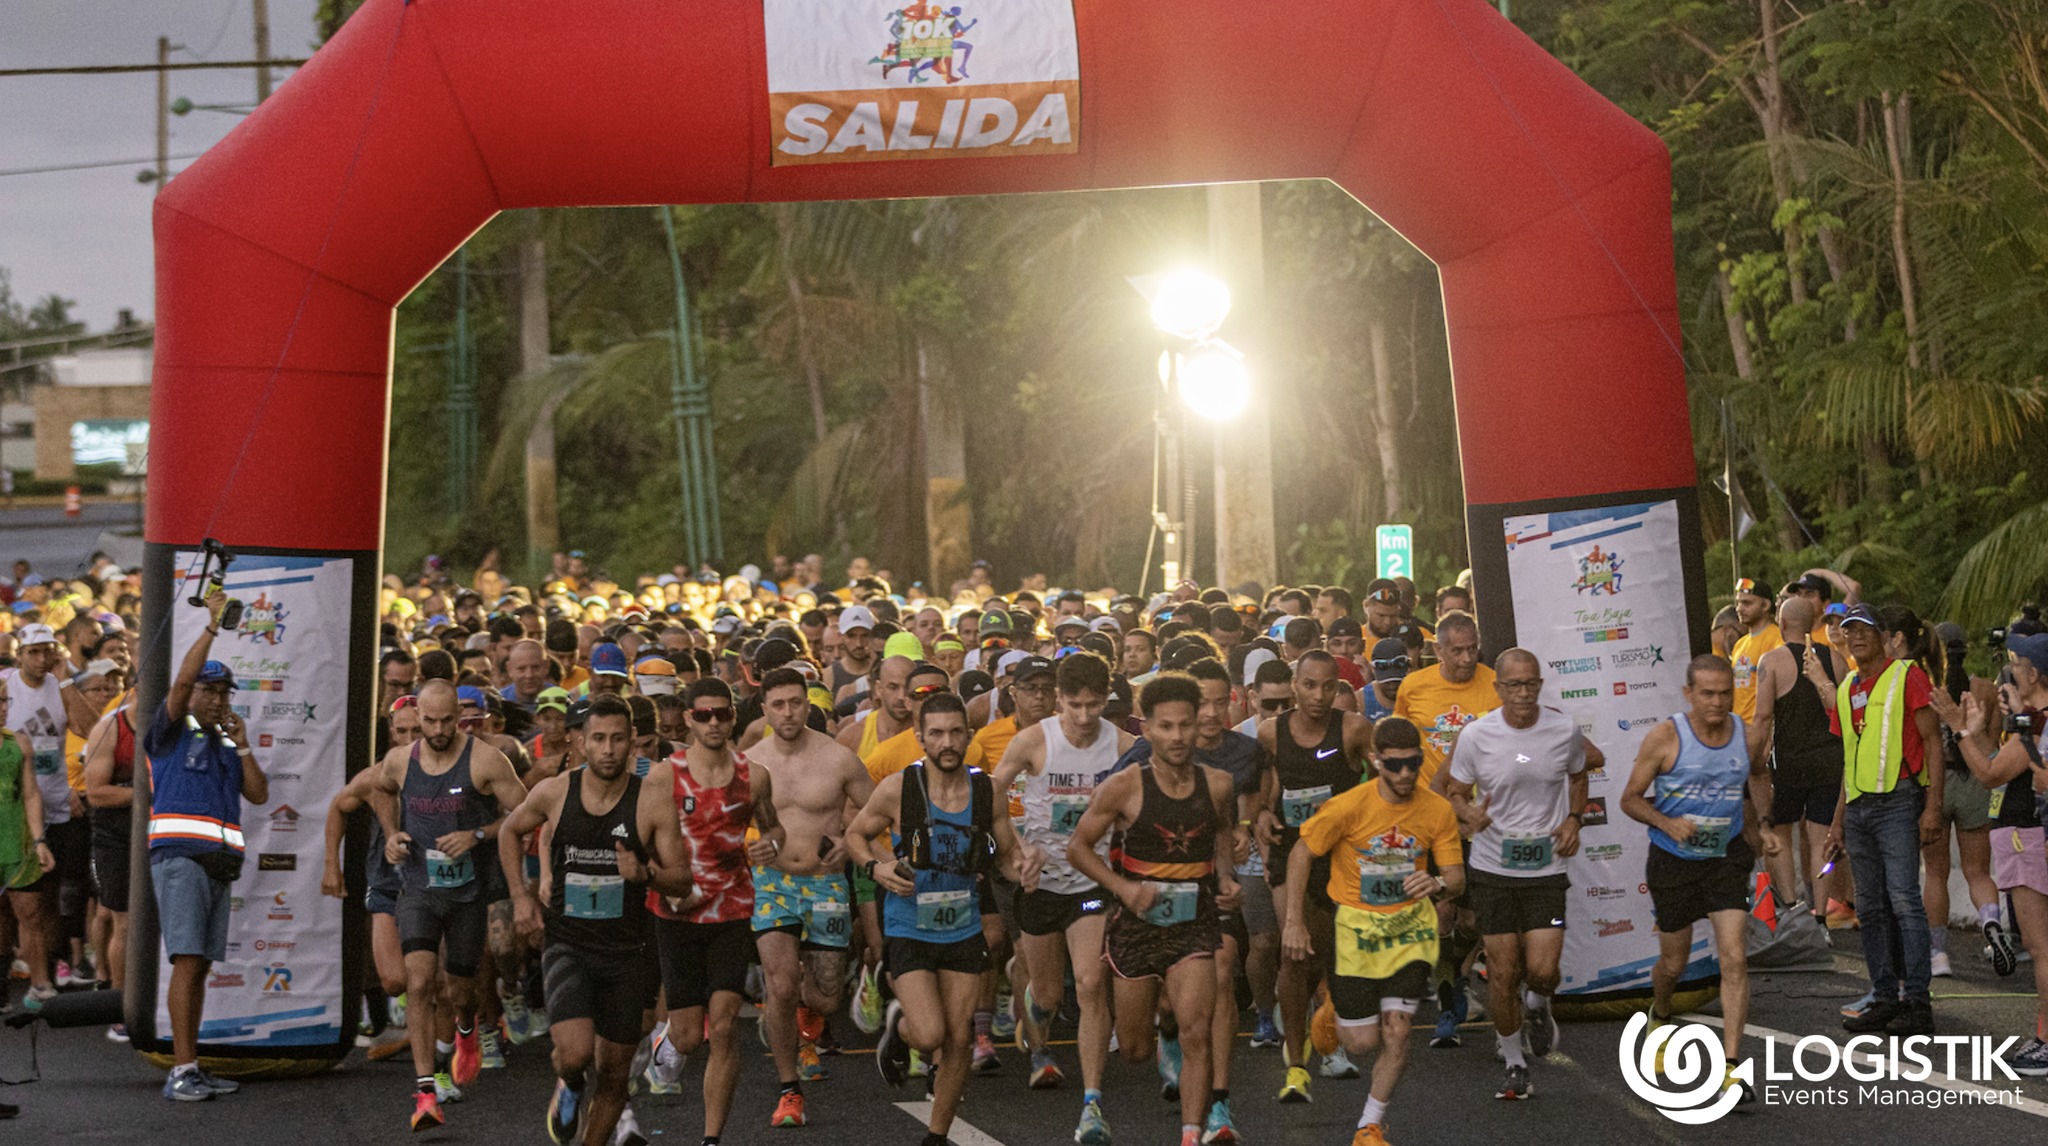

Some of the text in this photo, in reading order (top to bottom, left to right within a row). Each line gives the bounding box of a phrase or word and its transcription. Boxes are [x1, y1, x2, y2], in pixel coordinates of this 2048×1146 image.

[902, 18, 957, 41] 10K
[778, 93, 1072, 156] SALIDA
[1381, 534, 1407, 550] km
[1386, 553, 1403, 577] 2
[1586, 560, 1614, 573] 10K
[1574, 608, 1634, 624] Toa Baja
[1611, 652, 1650, 664] TURISMO
[1629, 682, 1658, 691] TOYOTA
[1631, 716, 1659, 726] LOGISTIK
[1048, 773, 1075, 787] TIME
[1078, 774, 1092, 787] TO
[1511, 845, 1544, 862] 590
[436, 861, 465, 880] 447
[588, 892, 597, 910] 1
[1162, 898, 1173, 918] 3
[933, 907, 956, 926] 40
[825, 917, 845, 935] 80
